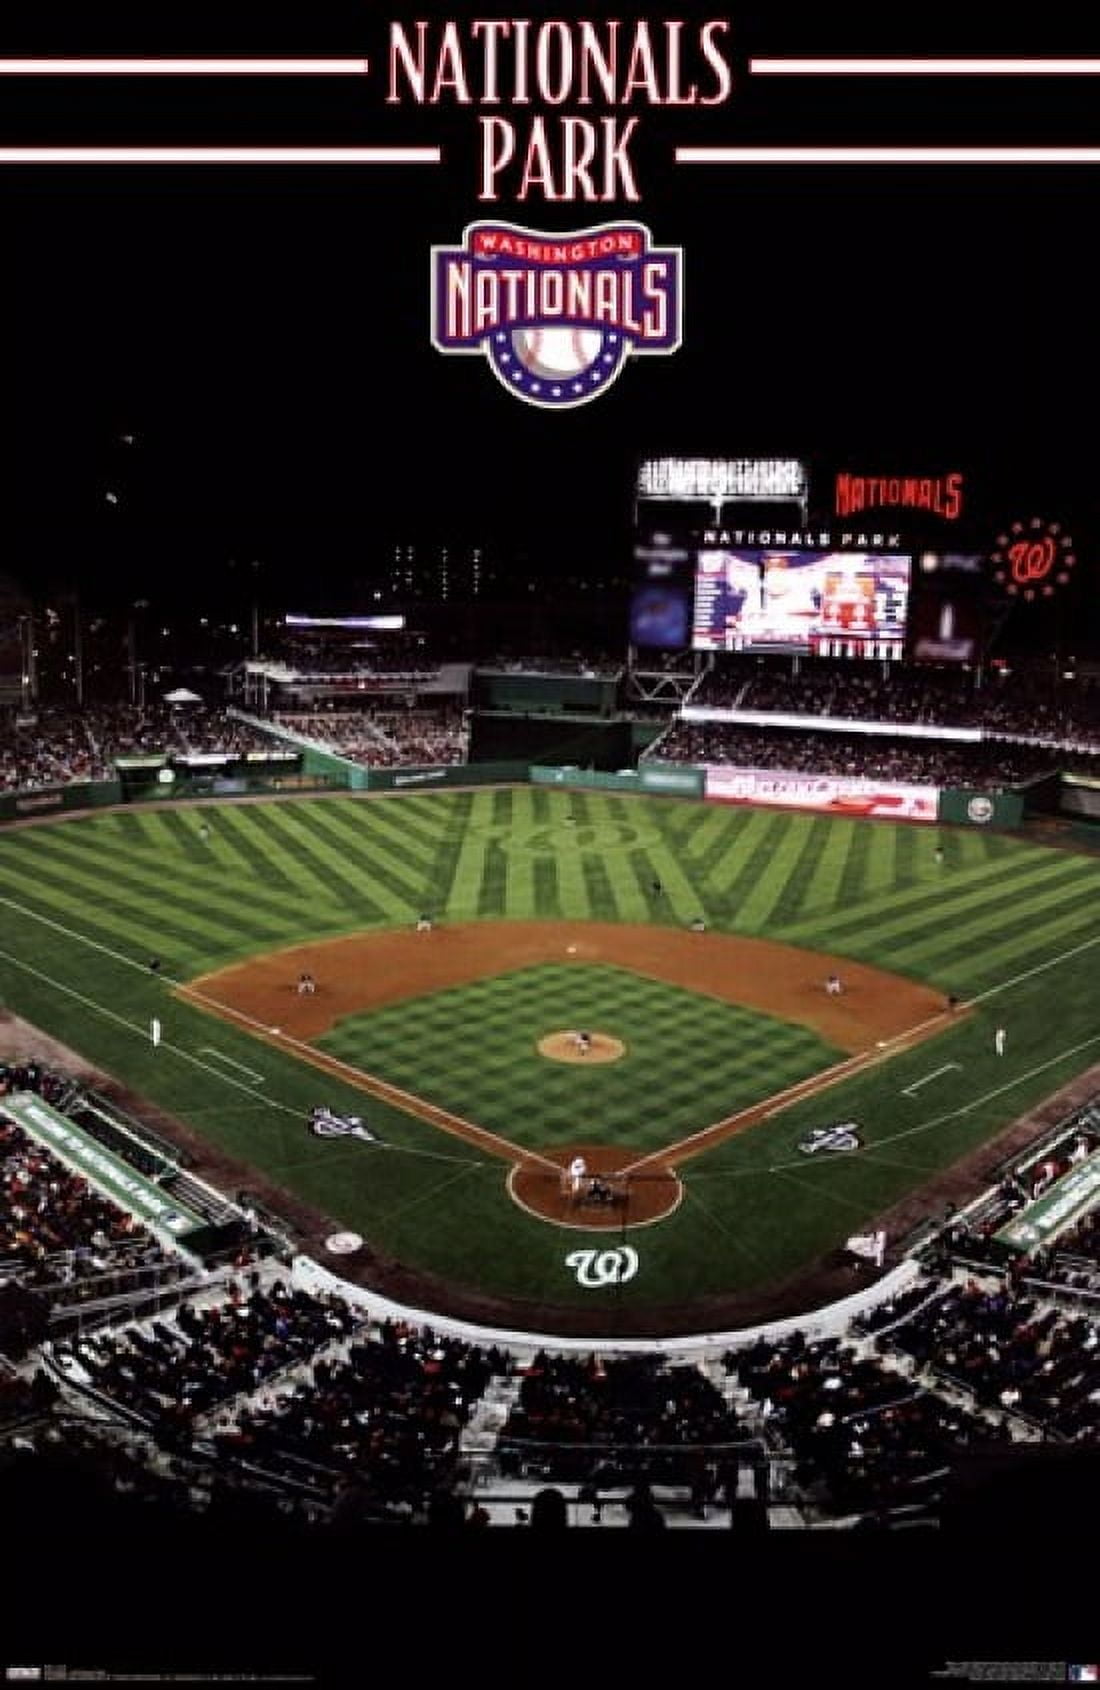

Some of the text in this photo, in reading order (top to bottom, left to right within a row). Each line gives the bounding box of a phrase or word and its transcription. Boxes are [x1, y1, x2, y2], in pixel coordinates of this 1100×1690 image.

[835, 472, 963, 520] NATIONALS
[703, 530, 901, 547] NATIONALS PARK
